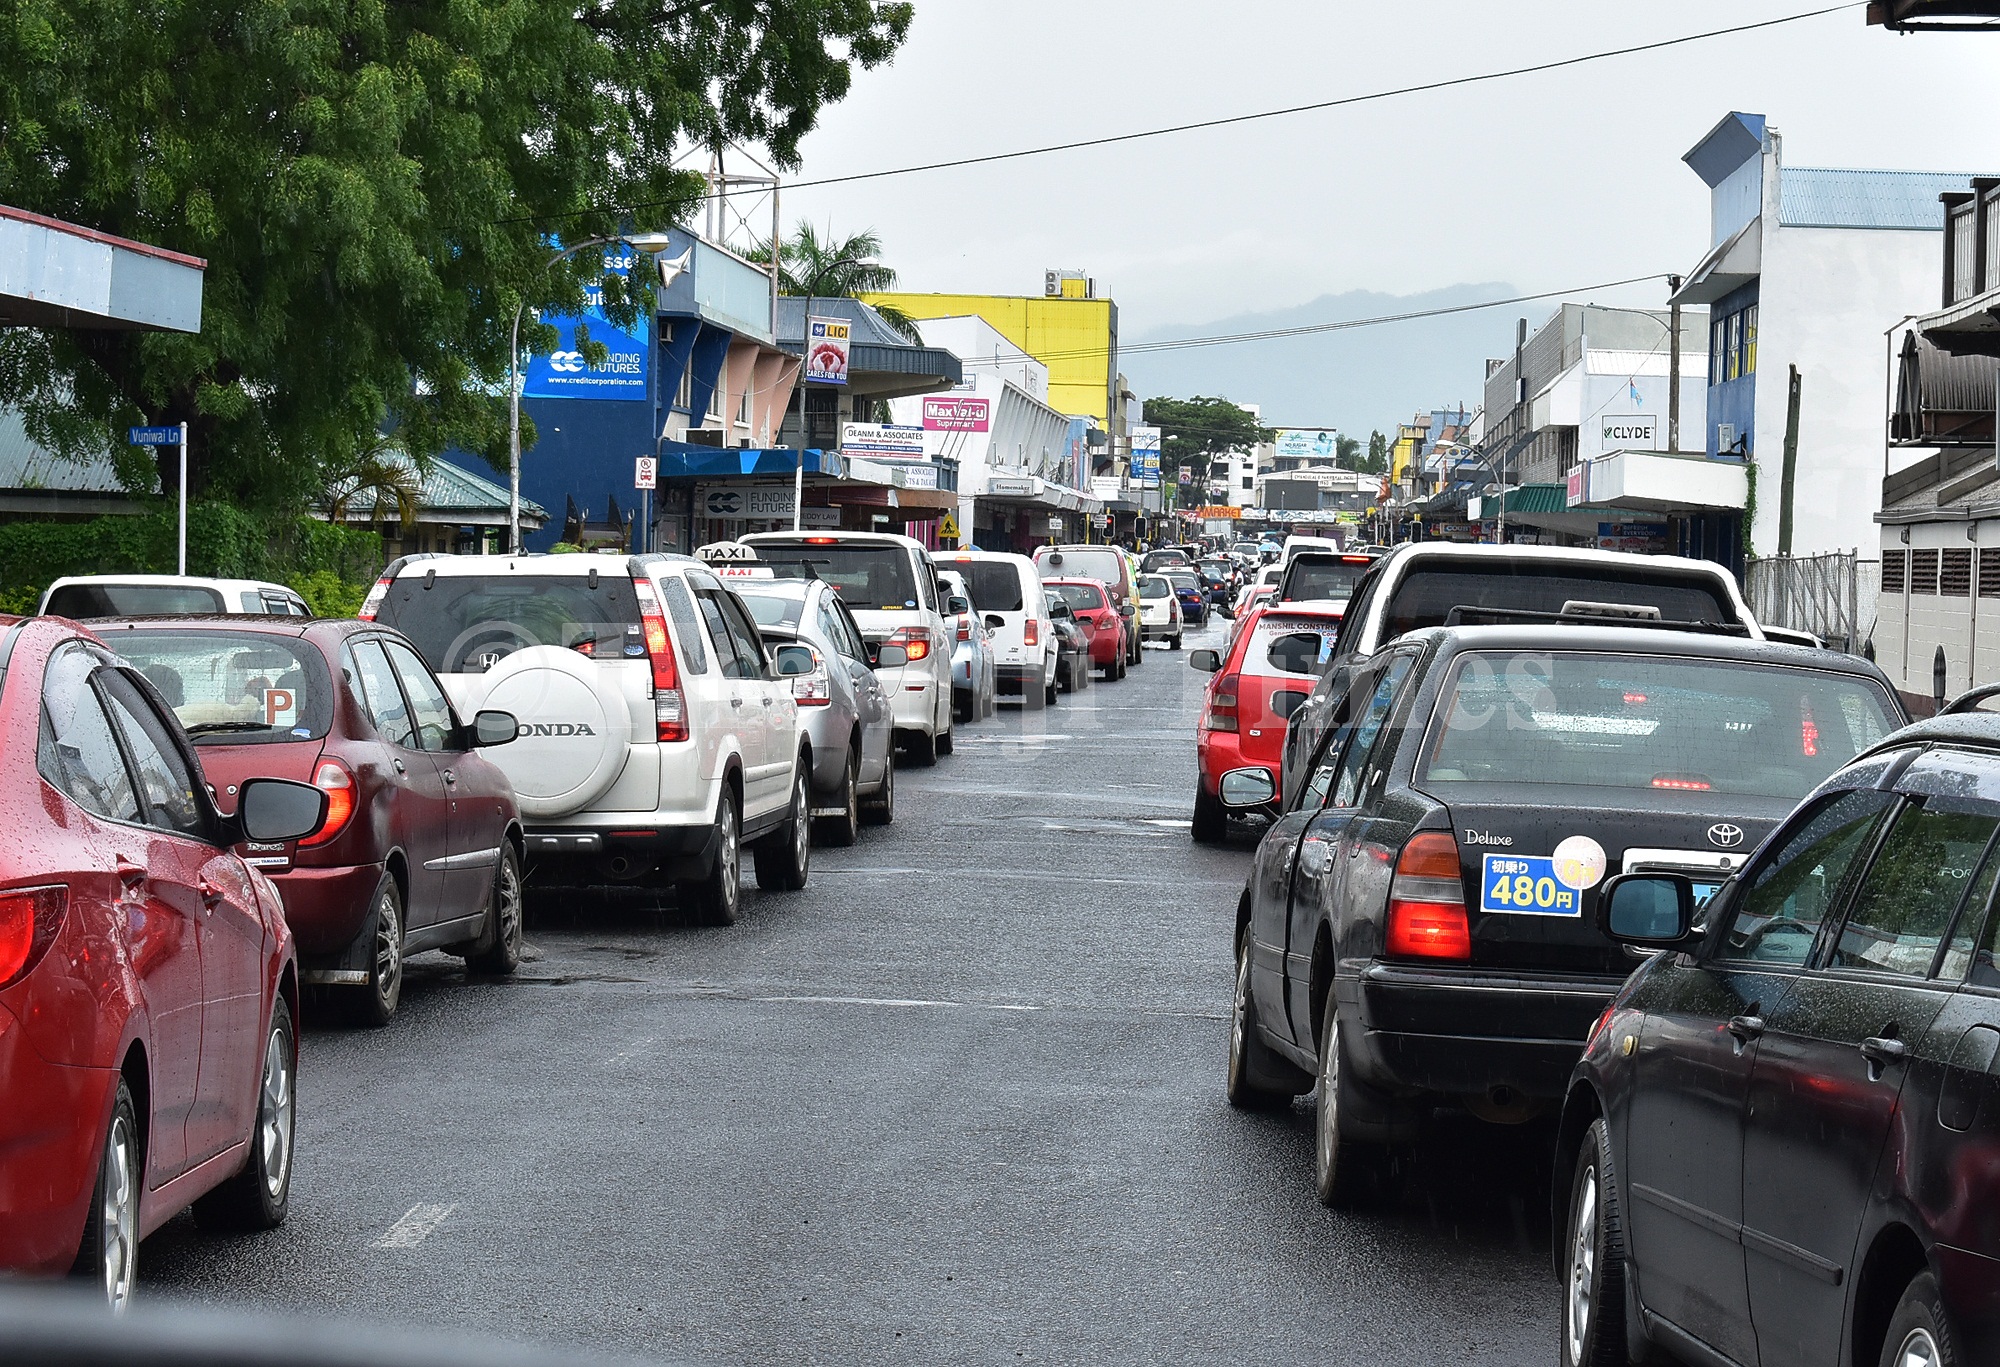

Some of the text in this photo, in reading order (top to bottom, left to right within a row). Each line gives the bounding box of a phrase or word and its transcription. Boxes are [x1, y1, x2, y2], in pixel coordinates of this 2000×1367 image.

[827, 325, 849, 338] LICI
[806, 369, 825, 378] CARES
[825, 370, 835, 379] FOR
[547, 376, 644, 386] www.creditcorporation.com
[131, 428, 179, 443] Vuniwai Ln
[876, 431, 882, 439] &
[883, 431, 924, 441] ASSOCIATES
[1613, 426, 1651, 439] CLYDE
[996, 483, 1030, 492] Homemaker
[701, 548, 746, 559] TAXI
[720, 568, 752, 576] TAXI
[1258, 622, 1338, 631] MANSHIL CONSTRU
[266, 689, 293, 725] P
[517, 723, 596, 737] ONDA
[1463, 829, 1514, 847] Deluxe
[1491, 859, 1529, 874] 初乗り
